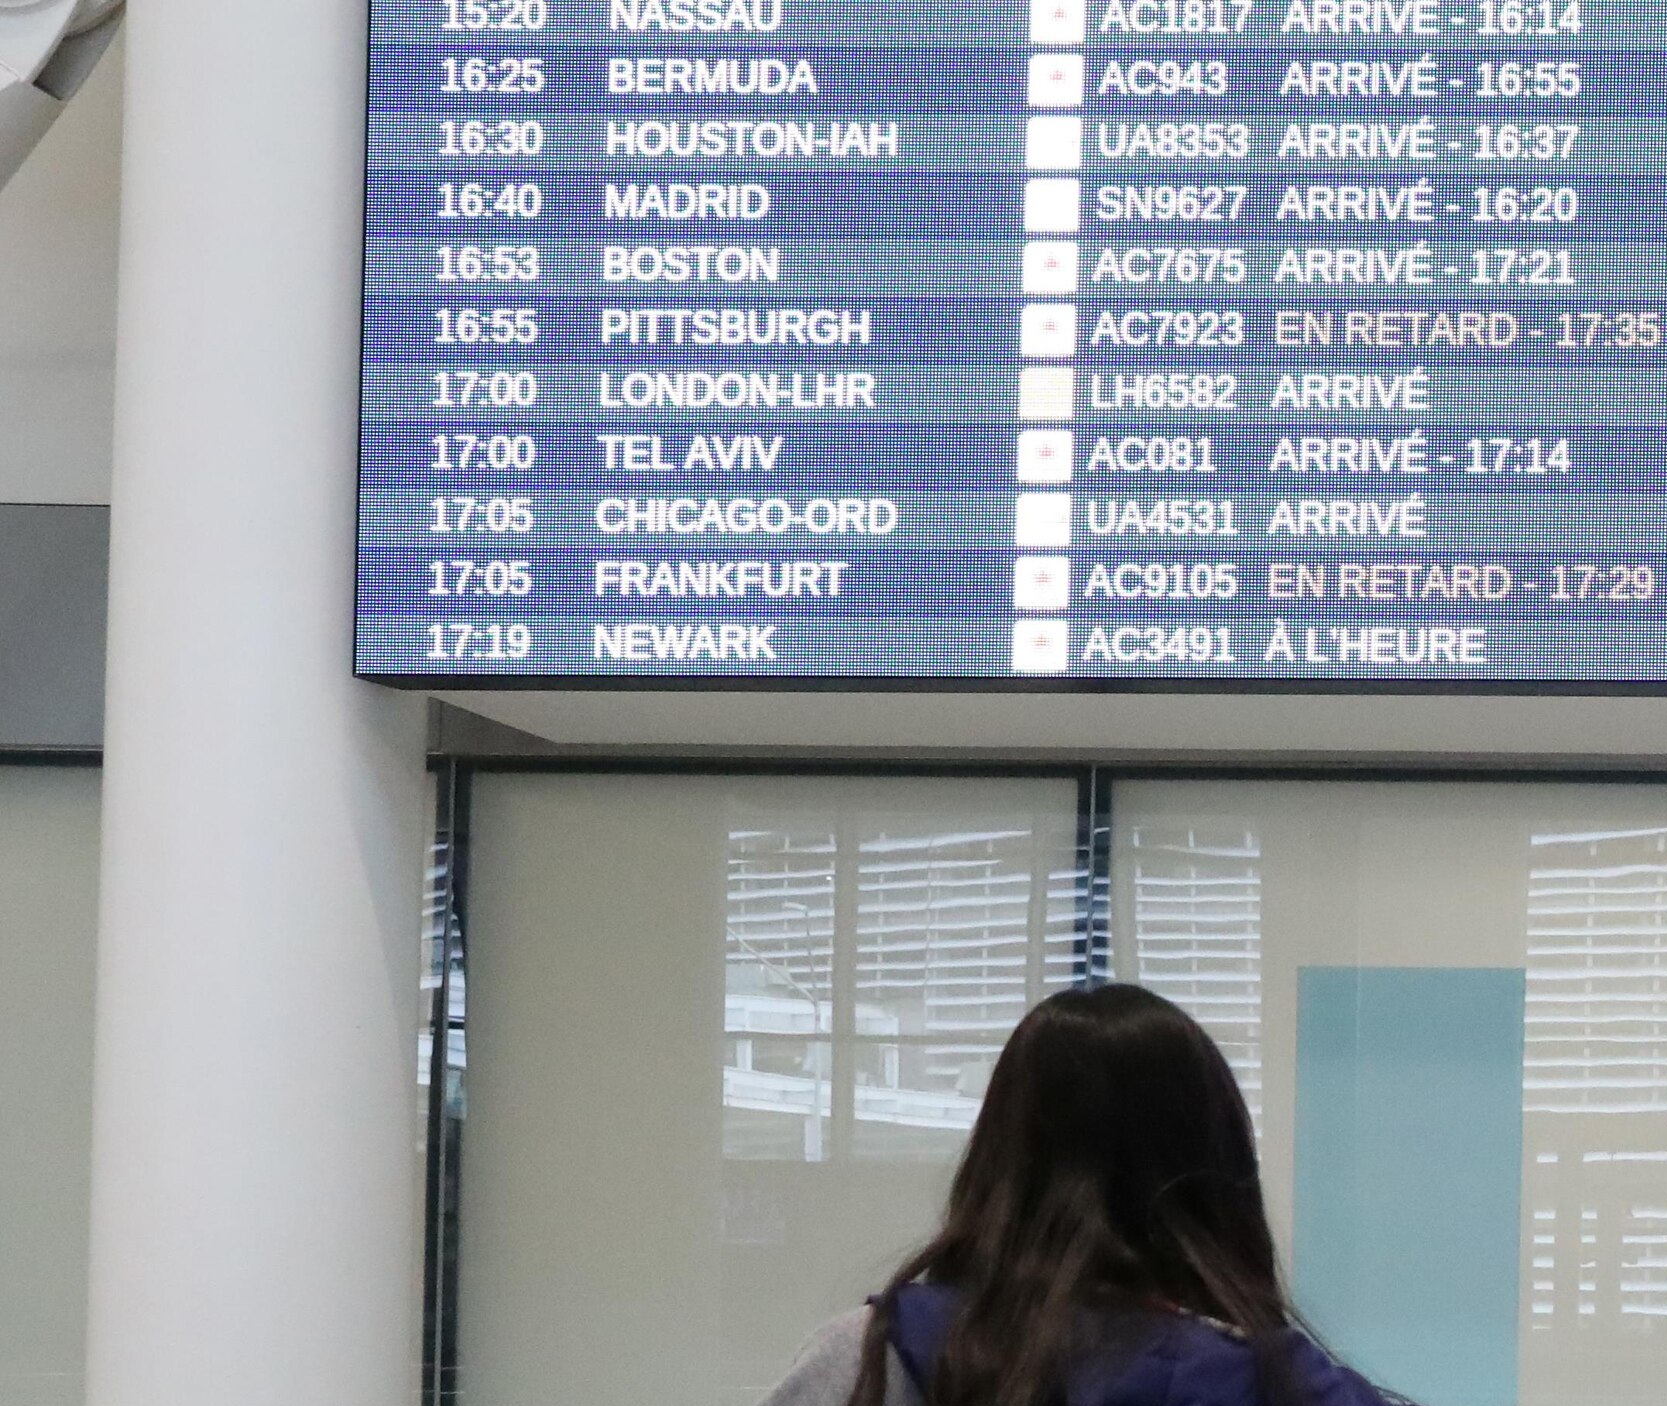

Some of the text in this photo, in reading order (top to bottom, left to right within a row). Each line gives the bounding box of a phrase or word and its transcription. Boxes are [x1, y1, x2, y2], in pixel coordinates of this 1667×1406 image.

[440, 57, 546, 94] 16:25
[607, 58, 819, 95] BERMUDA
[1098, 60, 1228, 96] AC943
[1279, 53, 1438, 98] ARRIVÉ
[1476, 61, 1582, 98] 16:55
[437, 182, 543, 219] 16:40
[603, 183, 771, 220] MADRID
[1096, 185, 1249, 221] SN9627
[1275, 178, 1434, 222] ARRIVÉ
[1472, 186, 1579, 223] 16:20
[434, 308, 539, 345] 16:55
[600, 308, 871, 345] PITTSBURGH
[1090, 310, 1245, 347] AC7923
[1274, 310, 1332, 347] EN
[1344, 310, 1519, 348] RETARD
[1556, 311, 1661, 348] 17:35
[431, 433, 537, 471] 17:00
[596, 434, 675, 471] TEL
[683, 434, 784, 471] AVIV
[1087, 436, 1217, 473] AC081
[1268, 430, 1429, 474] ARRIVÉ
[1465, 437, 1572, 474] 17:14
[426, 618, 1488, 666] 17:19 NEWARK AC3491 À L'HEURE
